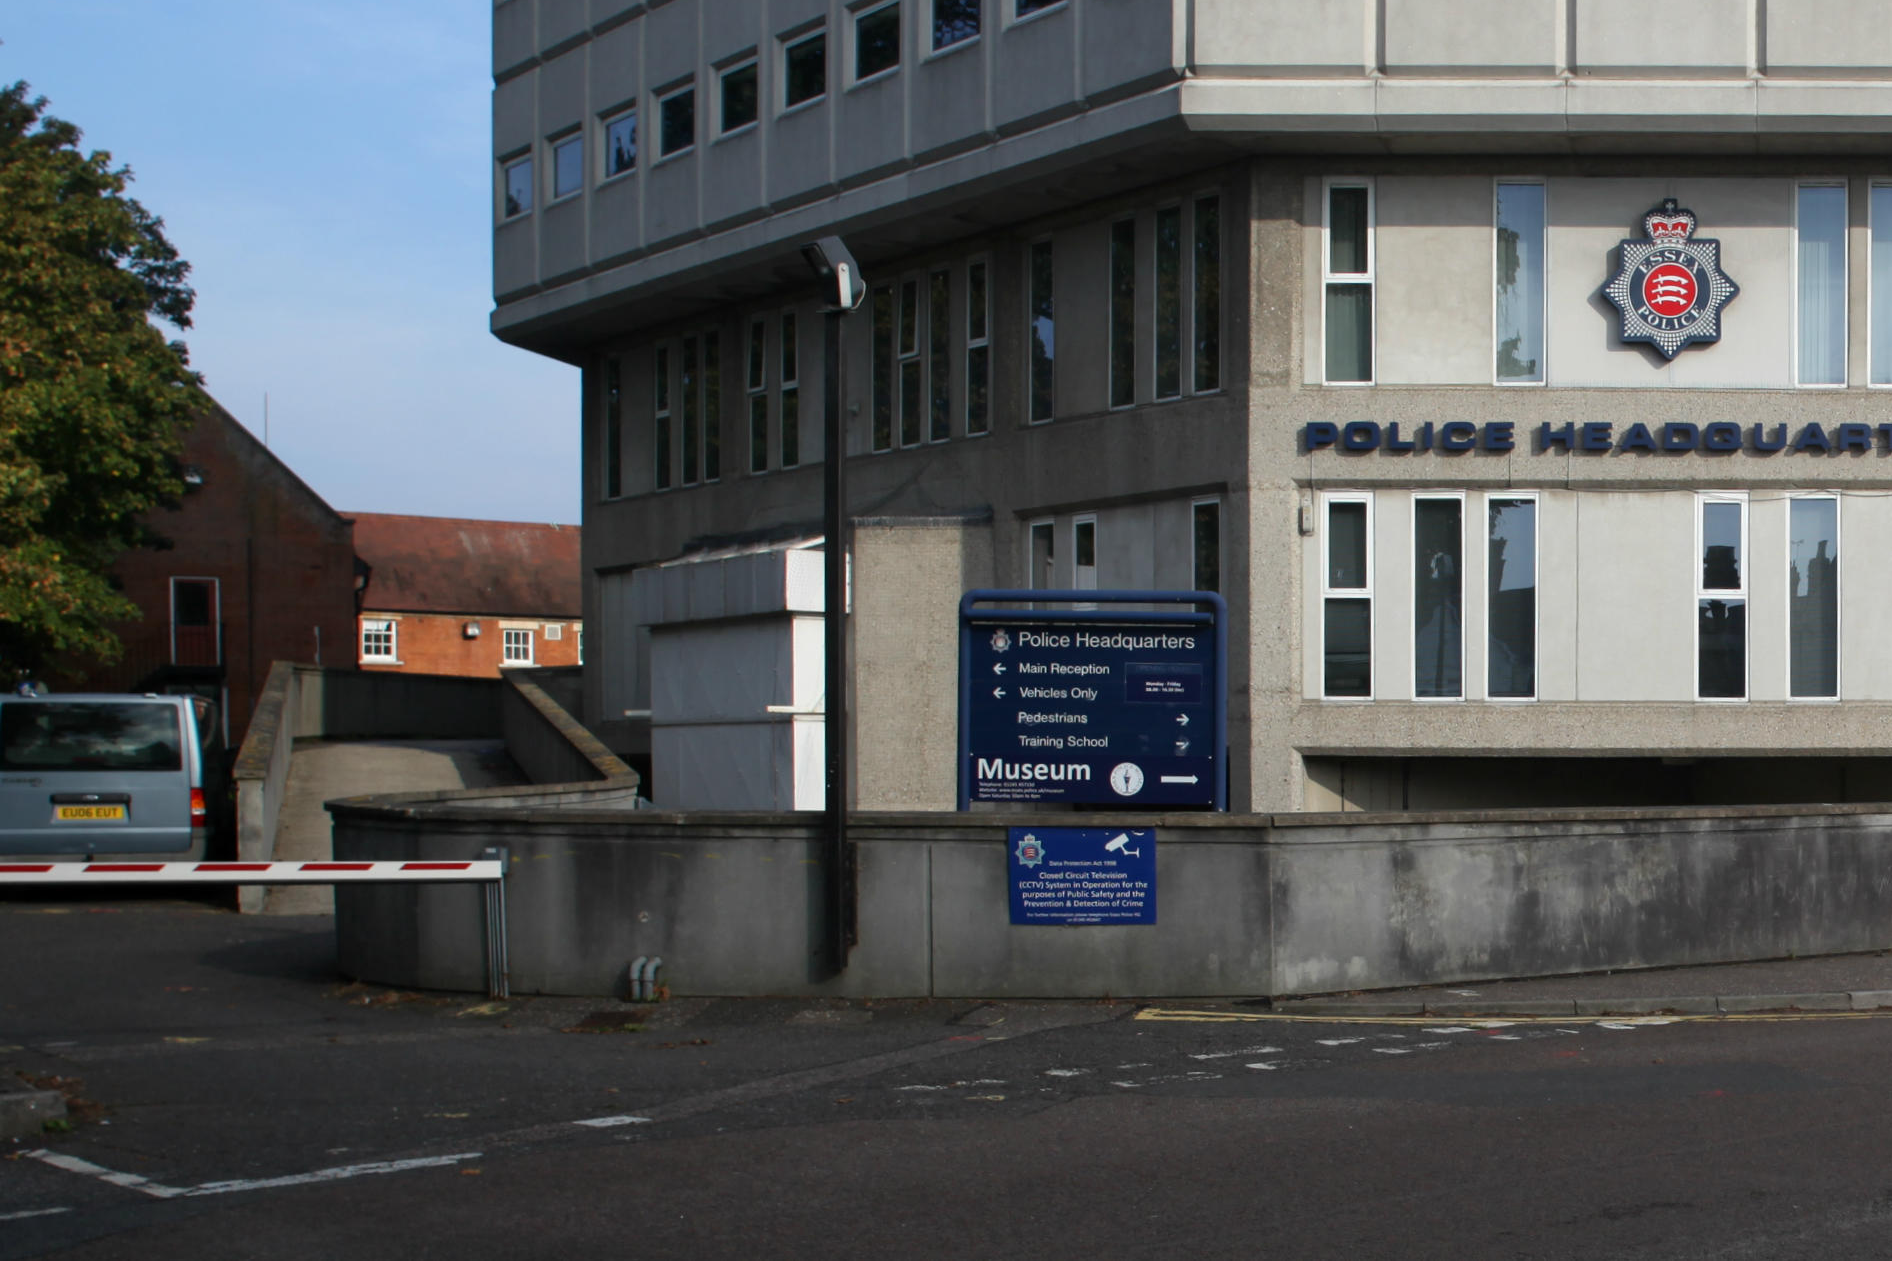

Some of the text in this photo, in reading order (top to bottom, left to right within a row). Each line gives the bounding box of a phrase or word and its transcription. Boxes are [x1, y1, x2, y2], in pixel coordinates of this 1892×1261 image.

[1638, 250, 1703, 274] ESSEX
[1637, 305, 1703, 330] POLICE
[1306, 421, 1515, 451] POLICE
[1019, 631, 1195, 651] Police Headquarters
[1019, 663, 1110, 676] Main Reception
[1019, 687, 1098, 700] Vehicles Only
[1018, 712, 1088, 724] Pedestrians
[1018, 735, 1108, 749] Training School
[978, 758, 1091, 780] Museum
[62, 807, 118, 817] EU06 EUT
[1019, 881, 1044, 889] (CCTV)
[1045, 881, 1071, 890] System
[1082, 881, 1120, 889] Operation
[1122, 881, 1134, 889] for
[1135, 881, 1148, 889] the
[1022, 891, 1056, 899] purposes
[1057, 890, 1066, 898] of
[1067, 890, 1090, 898] Public
[1091, 890, 1115, 899] Safety
